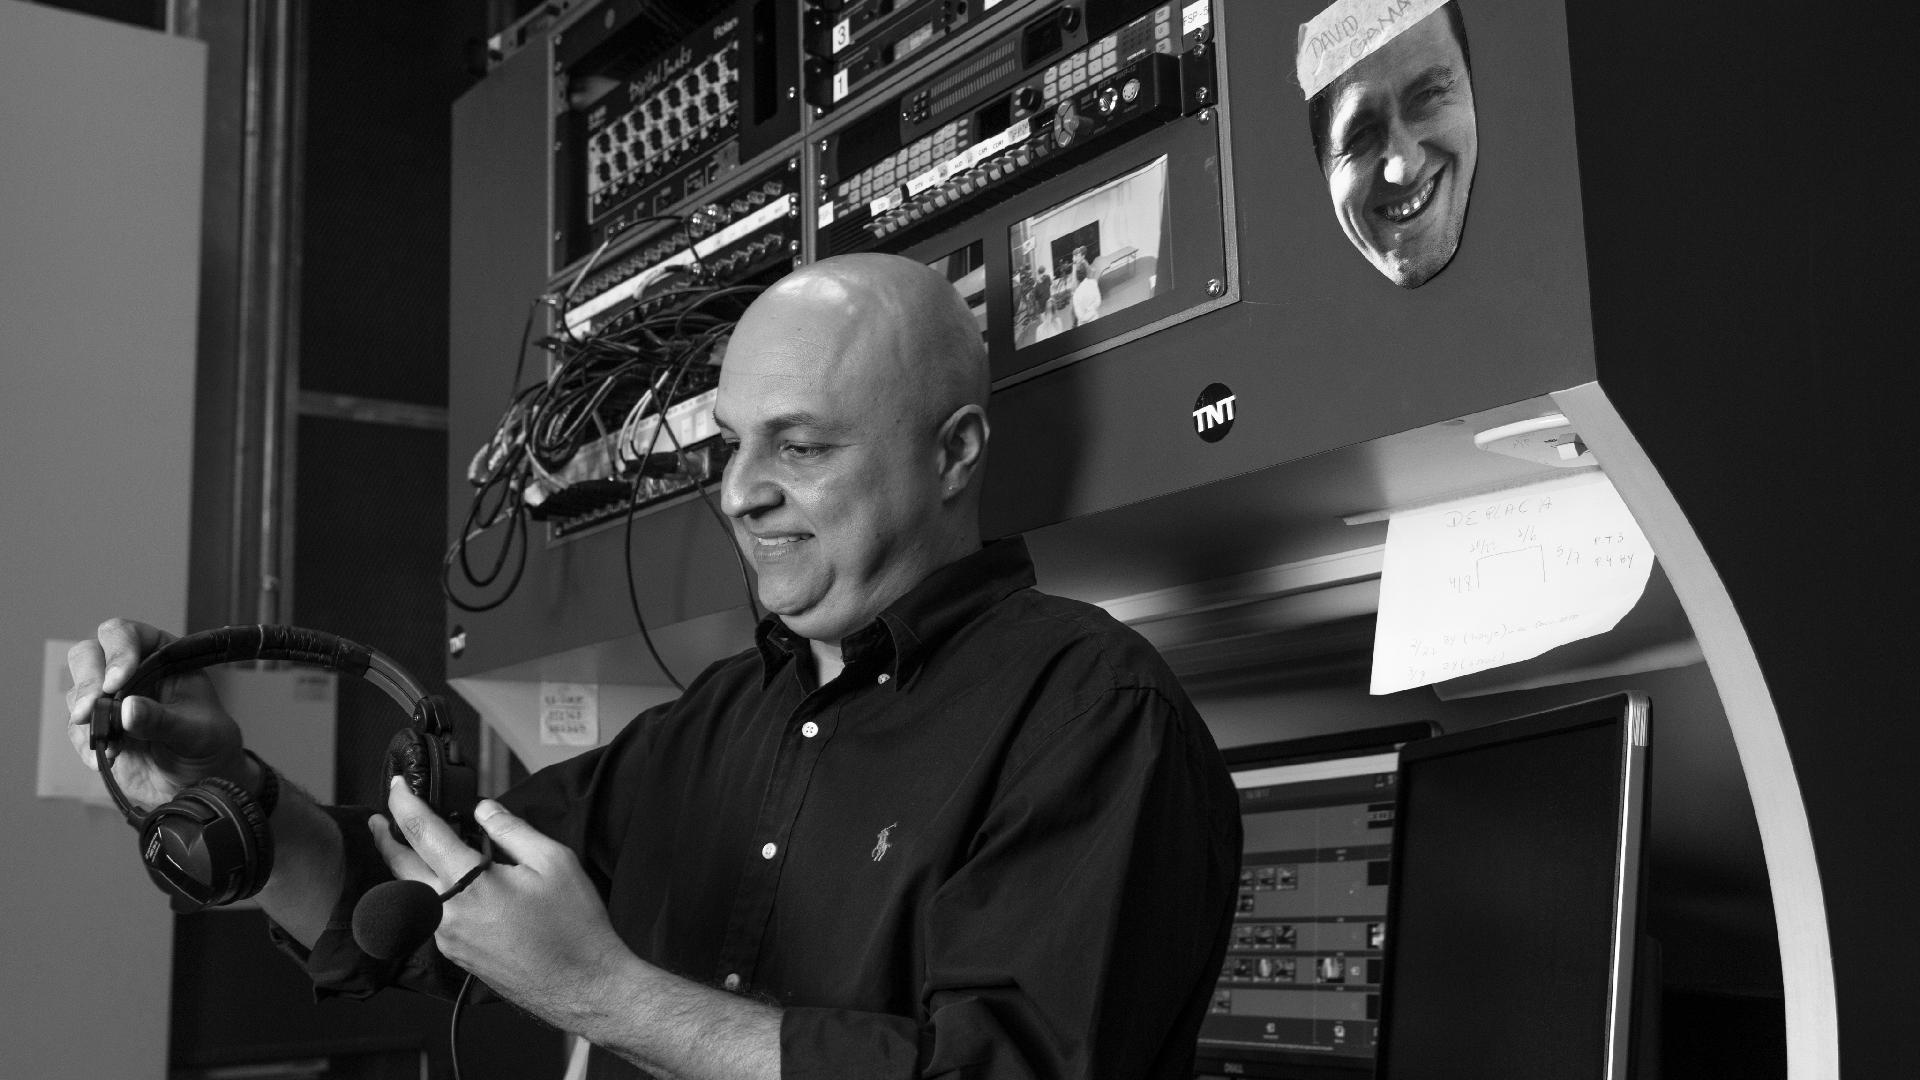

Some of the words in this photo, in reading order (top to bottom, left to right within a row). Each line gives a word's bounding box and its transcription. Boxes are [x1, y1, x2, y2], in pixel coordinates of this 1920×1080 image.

[838, 26, 846, 46] 3
[1306, 15, 1358, 59] DAVID
[1193, 395, 1235, 432] TNT
